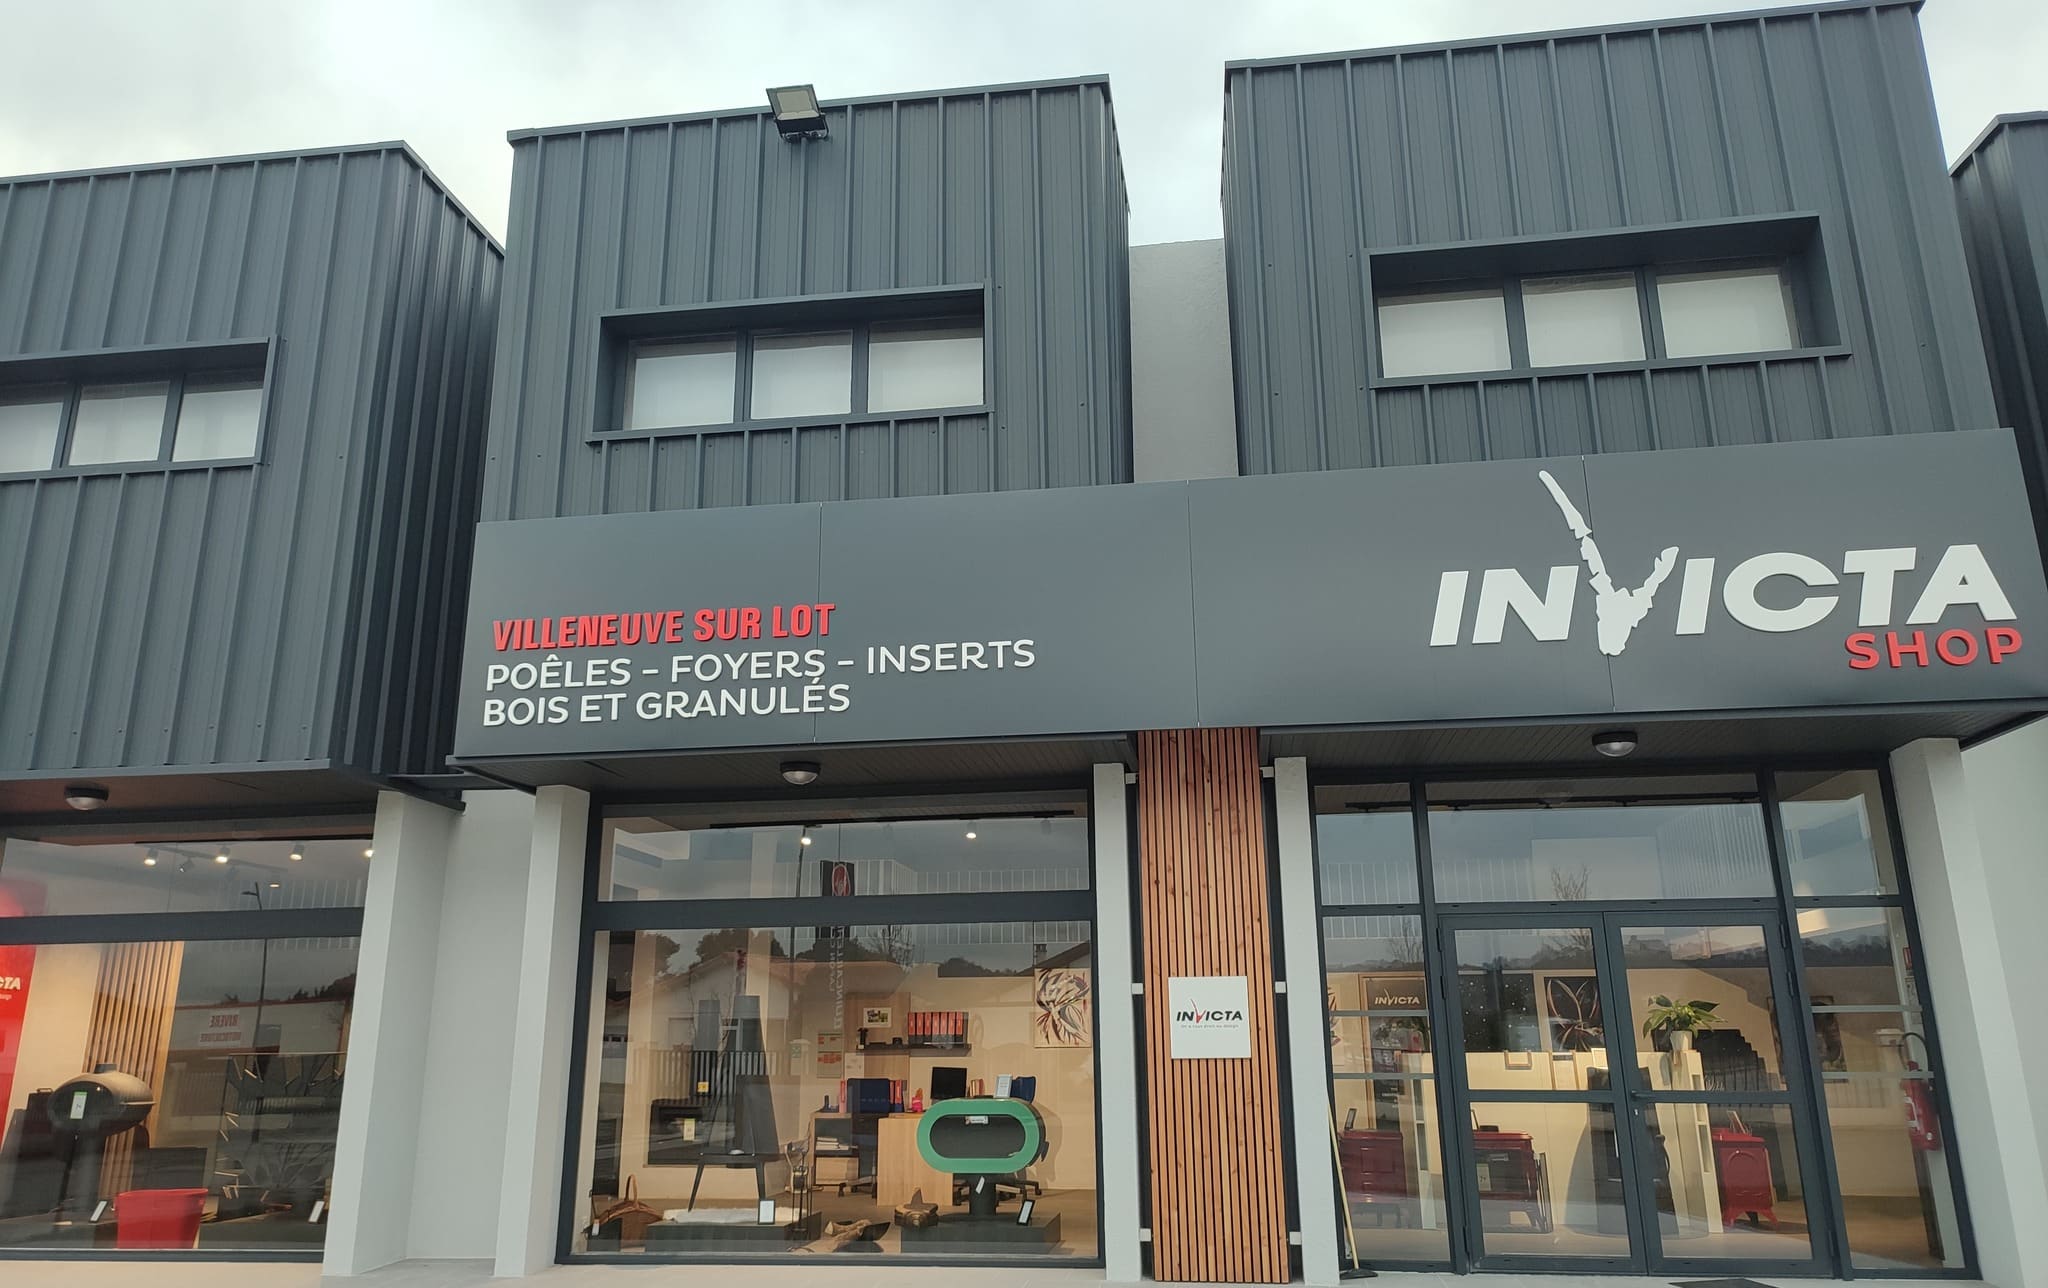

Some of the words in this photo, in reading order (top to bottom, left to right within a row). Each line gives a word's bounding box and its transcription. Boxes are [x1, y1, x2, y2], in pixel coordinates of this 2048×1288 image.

[1430, 470, 2017, 656] INVICTA
[493, 610, 685, 651] VILLENEUVE
[693, 607, 761, 642] SUR
[772, 603, 836, 639] LOT
[1845, 627, 2023, 670] SHOP
[486, 653, 633, 692] POÊLES
[671, 649, 827, 684] FOYERS
[867, 639, 1036, 675] INSERTS
[483, 696, 569, 727] BOIS
[580, 692, 628, 723] ET
[636, 677, 851, 720] GRANULÉS
[1176, 998, 1243, 1024] INVICTA
[1374, 987, 1421, 1006] INVICTA
